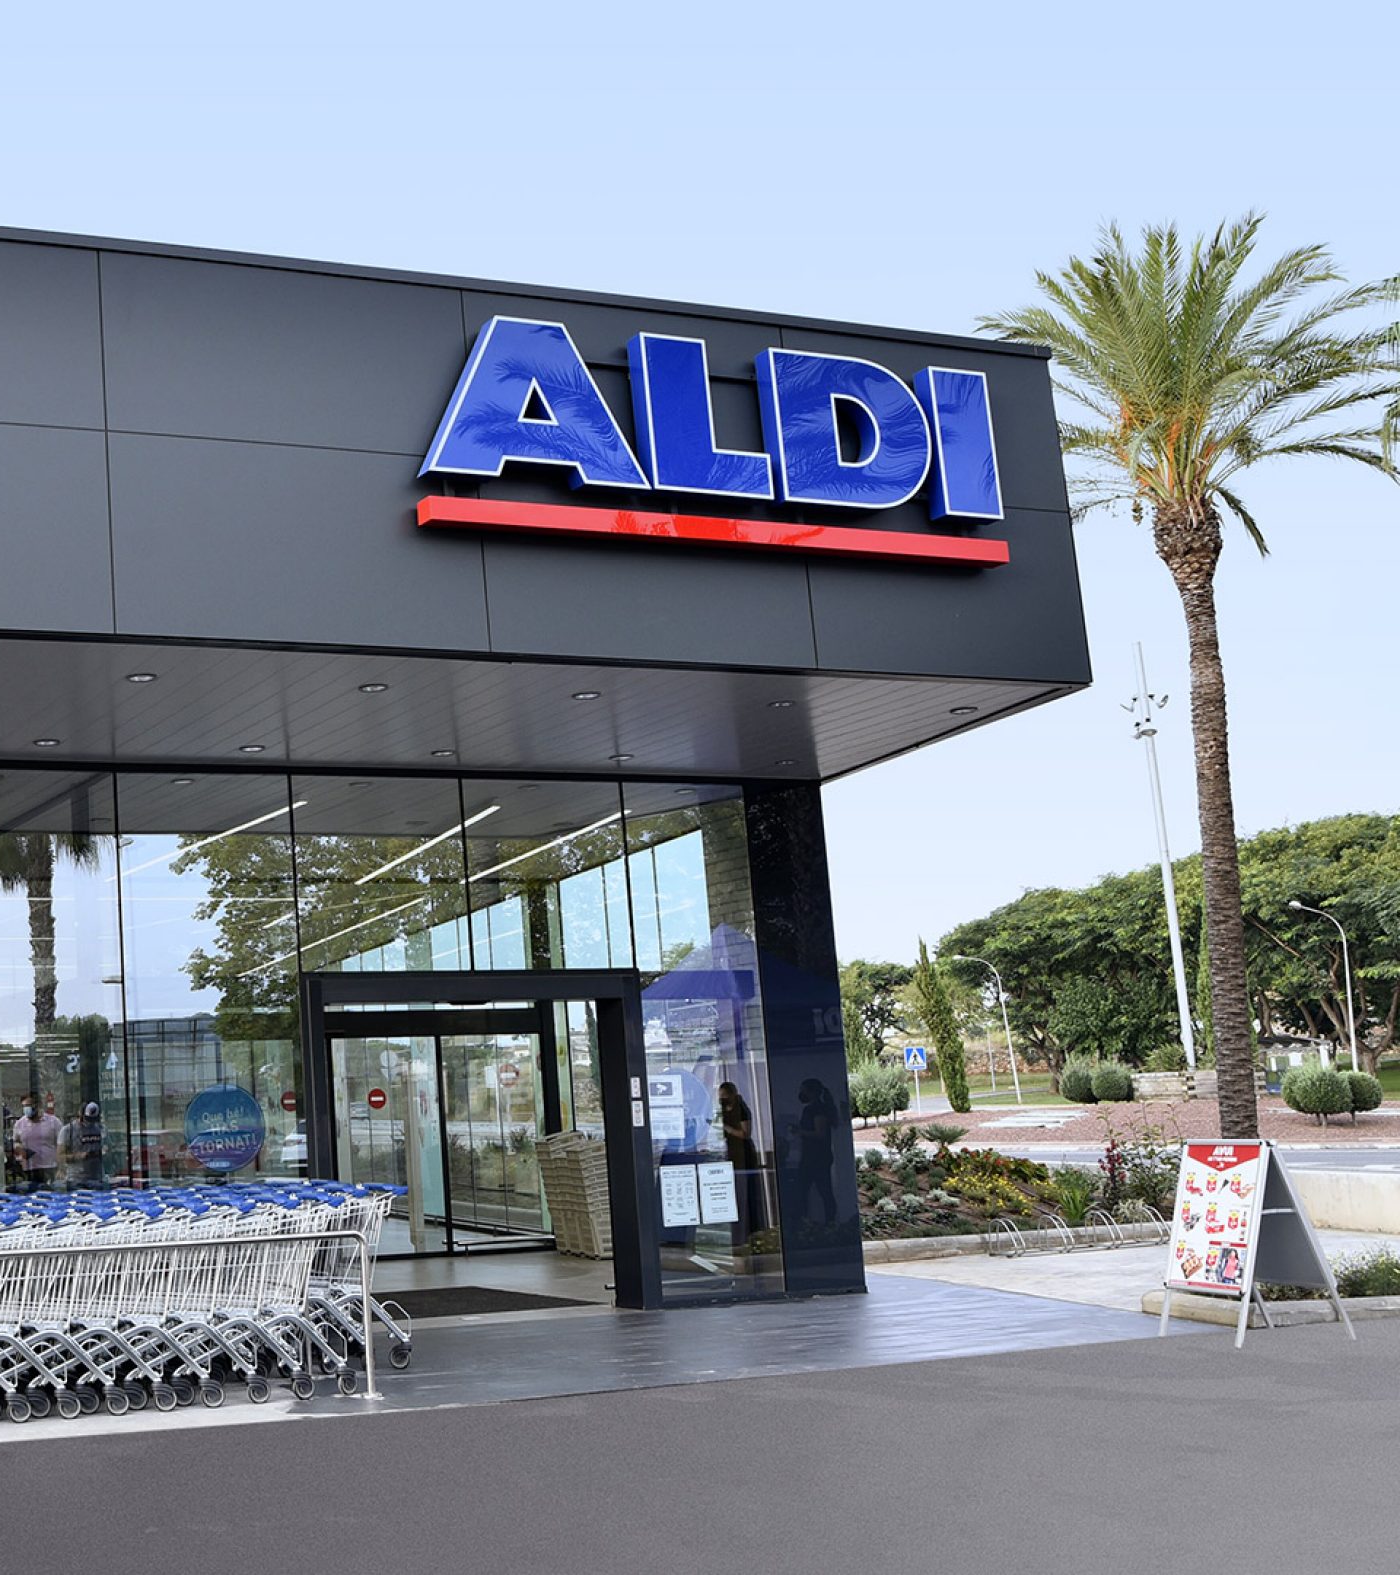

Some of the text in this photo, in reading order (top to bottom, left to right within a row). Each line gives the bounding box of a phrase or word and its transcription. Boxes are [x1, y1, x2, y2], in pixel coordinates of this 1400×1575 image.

[418, 315, 1005, 526] ALDI
[211, 1120, 238, 1136] HAS
[200, 1133, 257, 1154] TORNAT!
